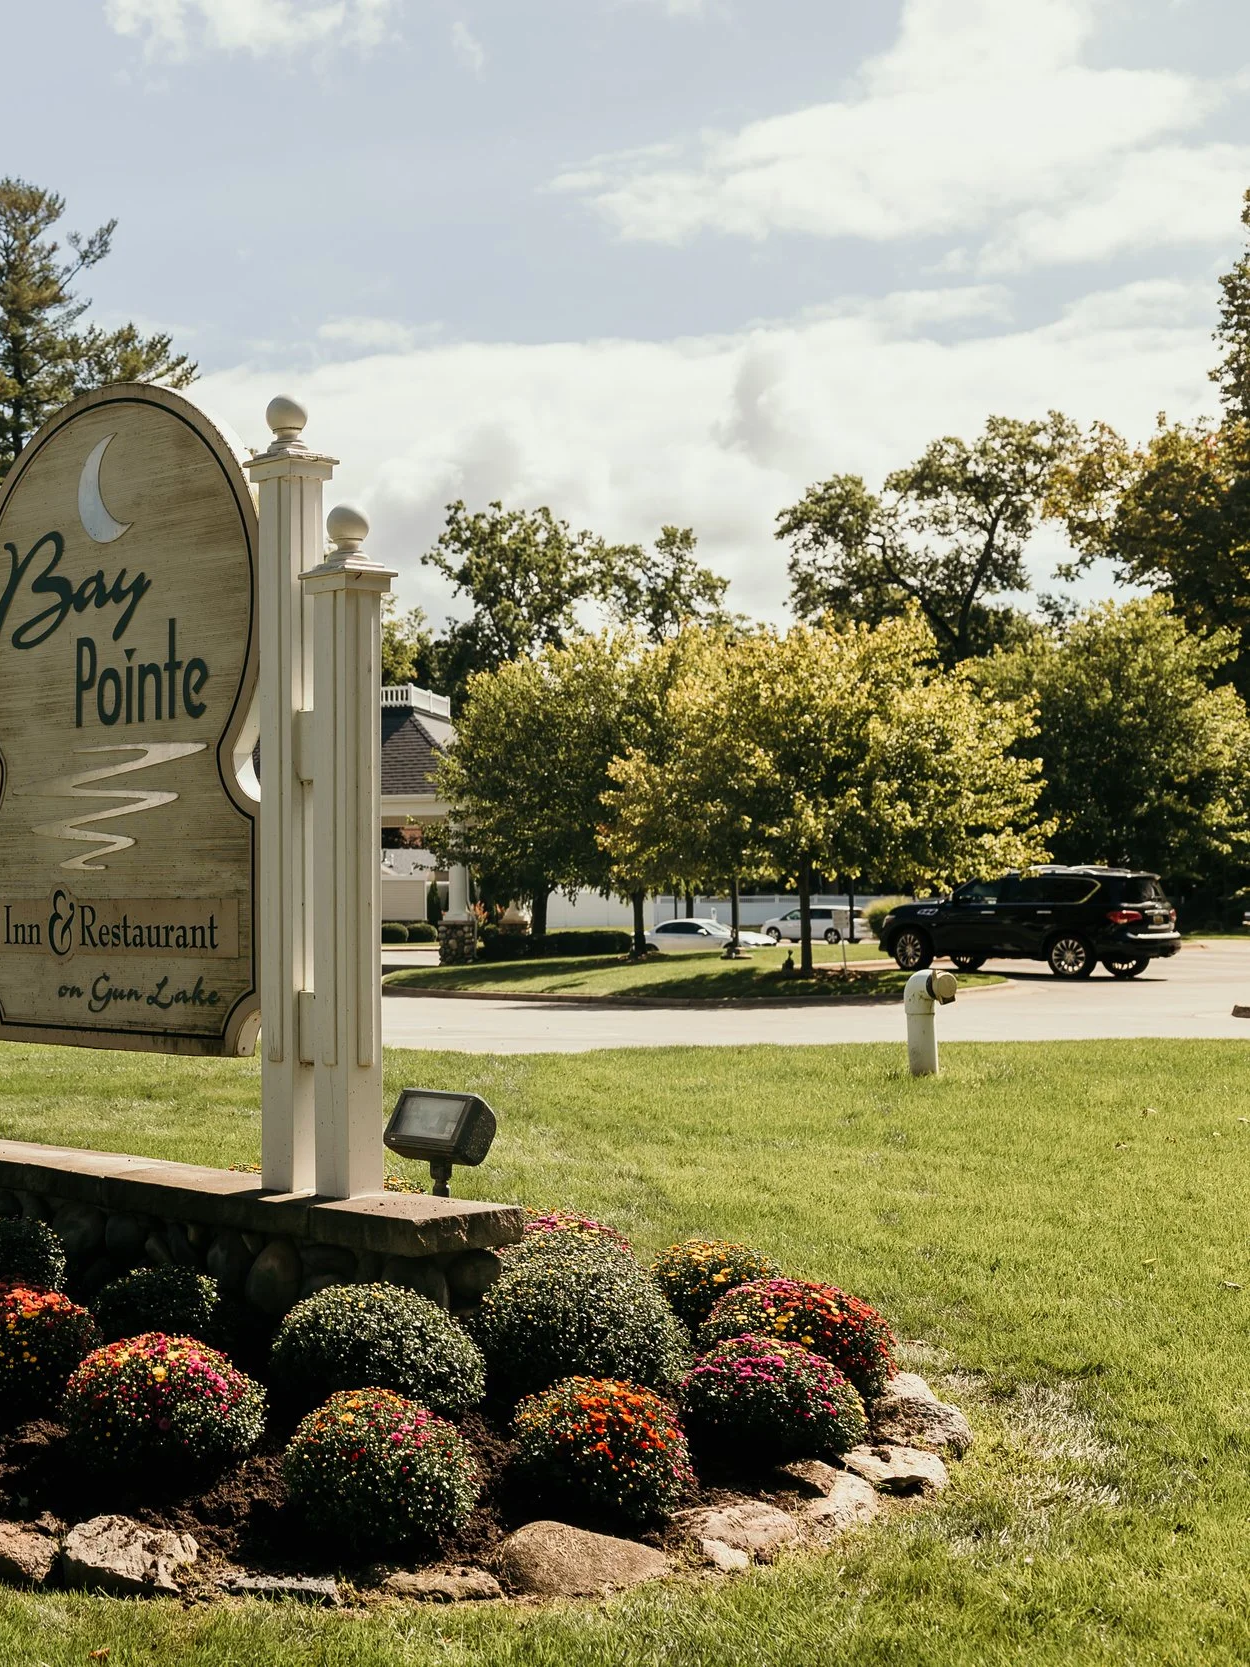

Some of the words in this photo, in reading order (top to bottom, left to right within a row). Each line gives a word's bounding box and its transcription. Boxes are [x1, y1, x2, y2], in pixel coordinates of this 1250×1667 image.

[75, 617, 209, 729] Pointe
[4, 904, 42, 946] Inn
[48, 889, 75, 956] &
[79, 904, 220, 950] Restaurant
[58, 985, 83, 1000] on
[88, 972, 143, 1013] Gun
[146, 975, 221, 1010] Lake
